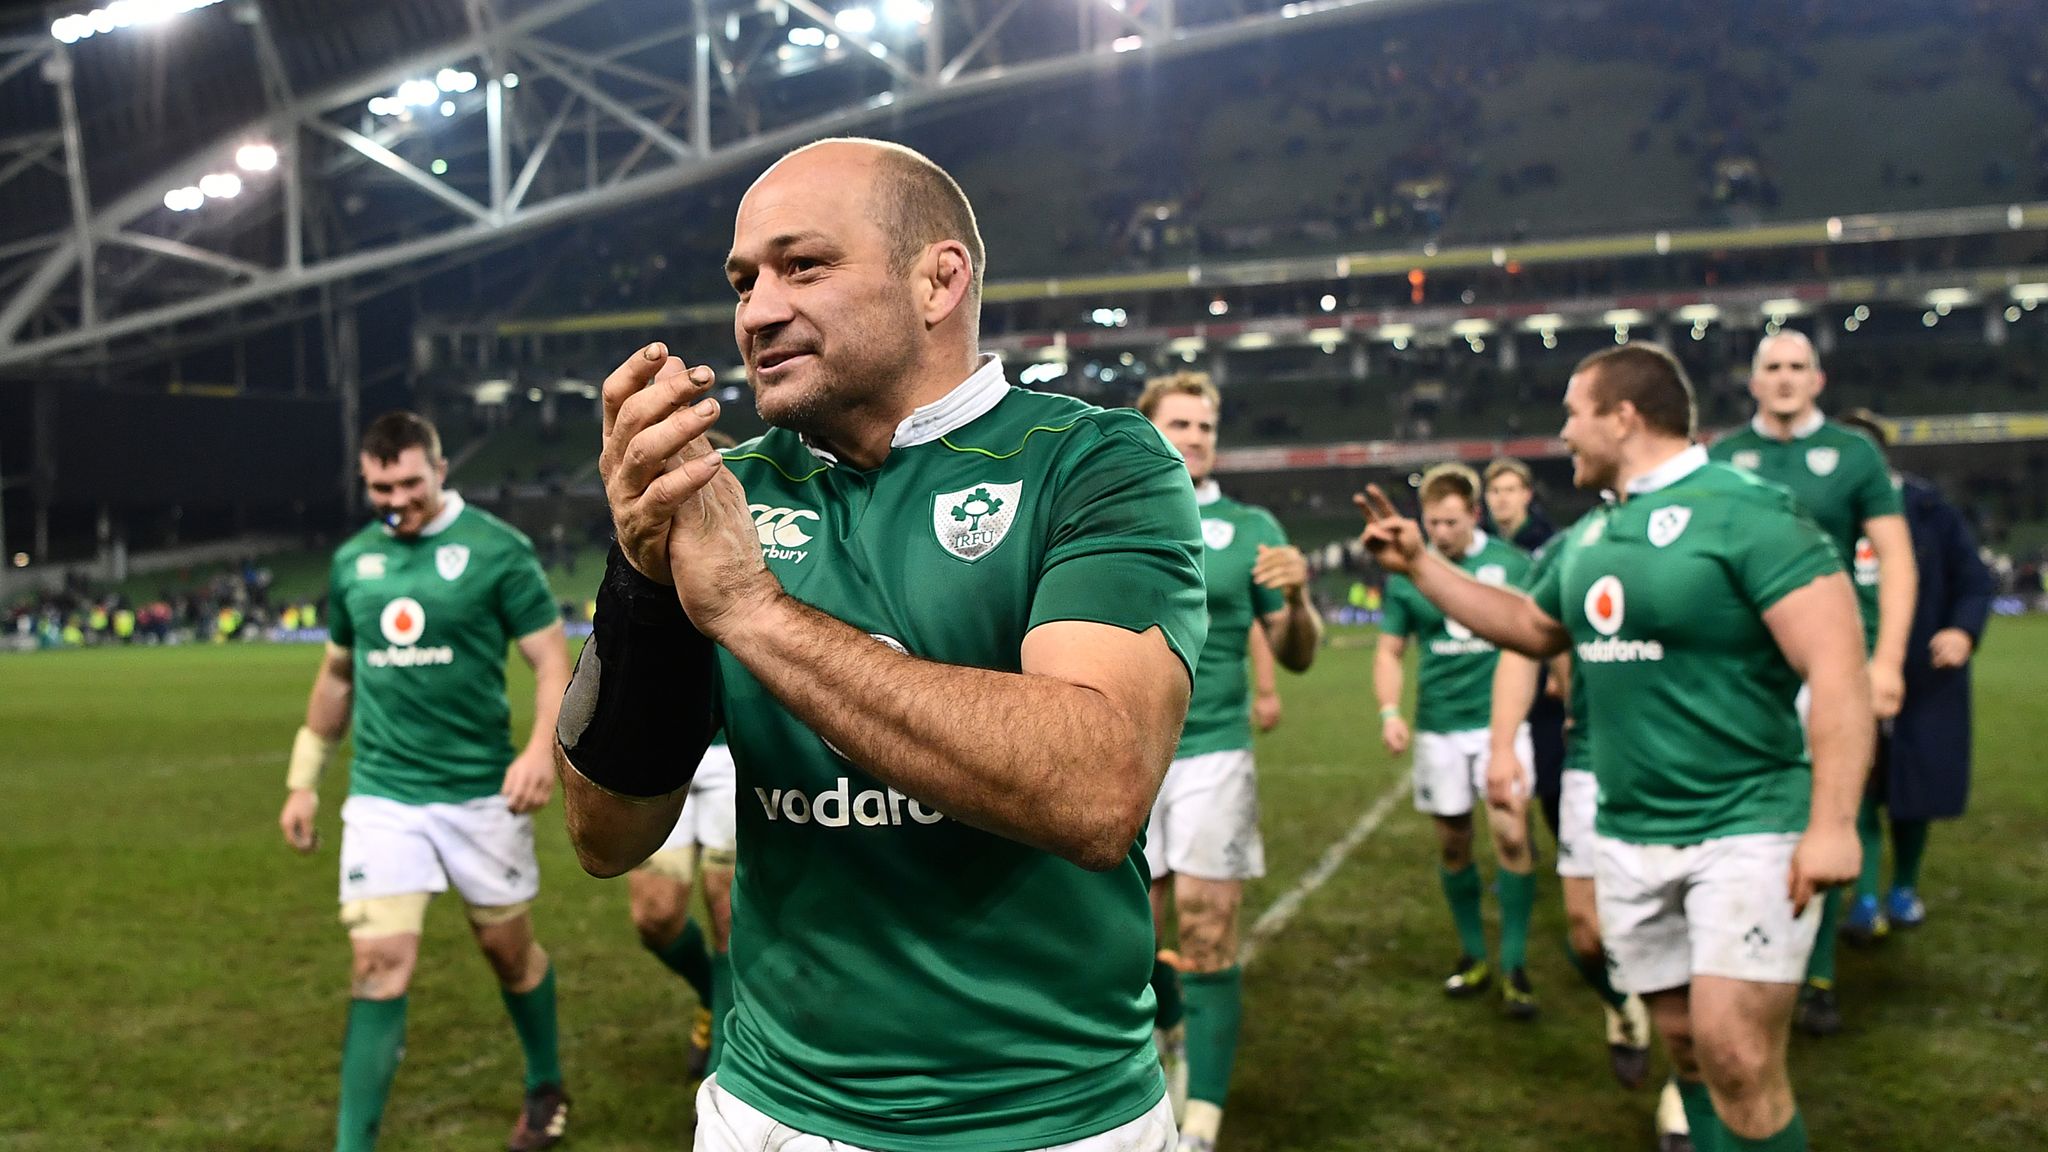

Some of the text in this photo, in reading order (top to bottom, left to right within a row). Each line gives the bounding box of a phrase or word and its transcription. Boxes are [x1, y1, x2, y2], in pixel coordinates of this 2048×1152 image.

[953, 530, 994, 549] IRFU
[762, 544, 808, 564] rbury
[754, 777, 945, 828] vodafo
